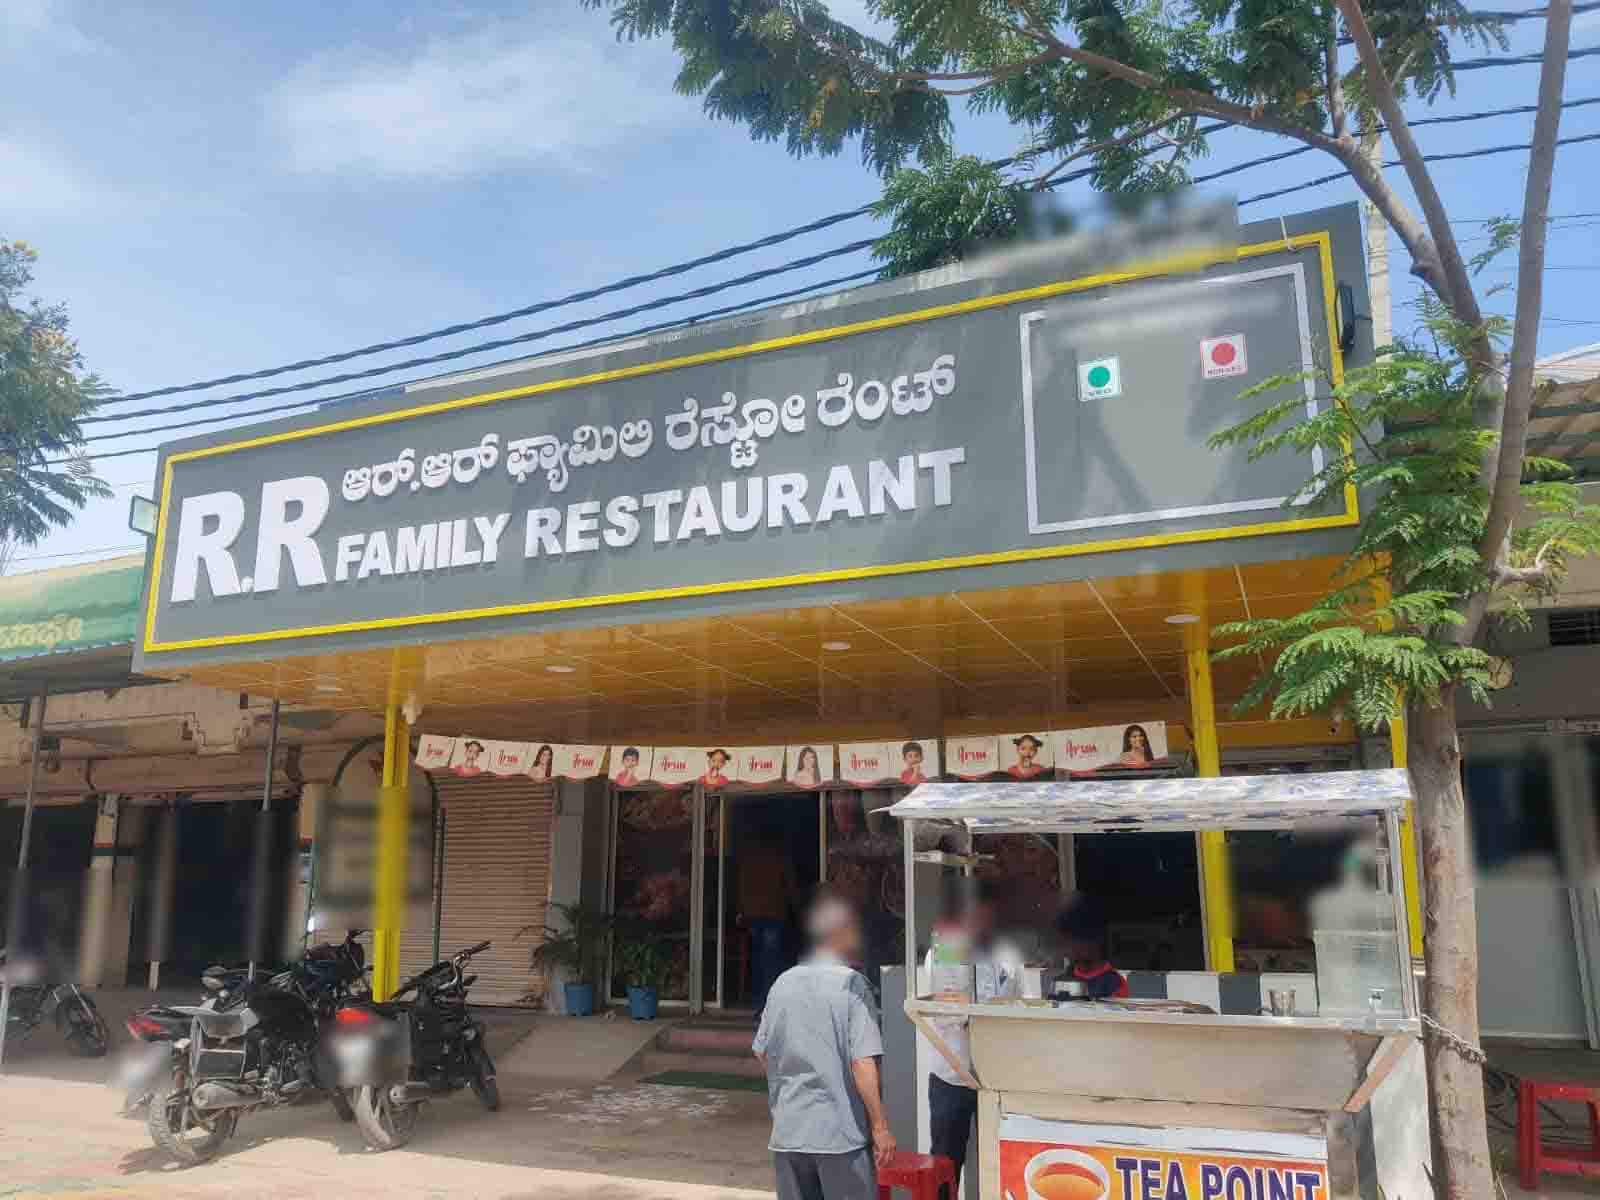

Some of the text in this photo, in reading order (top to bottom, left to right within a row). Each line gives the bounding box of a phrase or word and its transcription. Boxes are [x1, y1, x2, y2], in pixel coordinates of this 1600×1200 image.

[507, 419, 653, 492] ಫ್ಯಾಮಿಲಿ
[170, 447, 966, 603] R.R FAMILY RESTAURANT
[1115, 1157, 1321, 1200] TEA POINT
